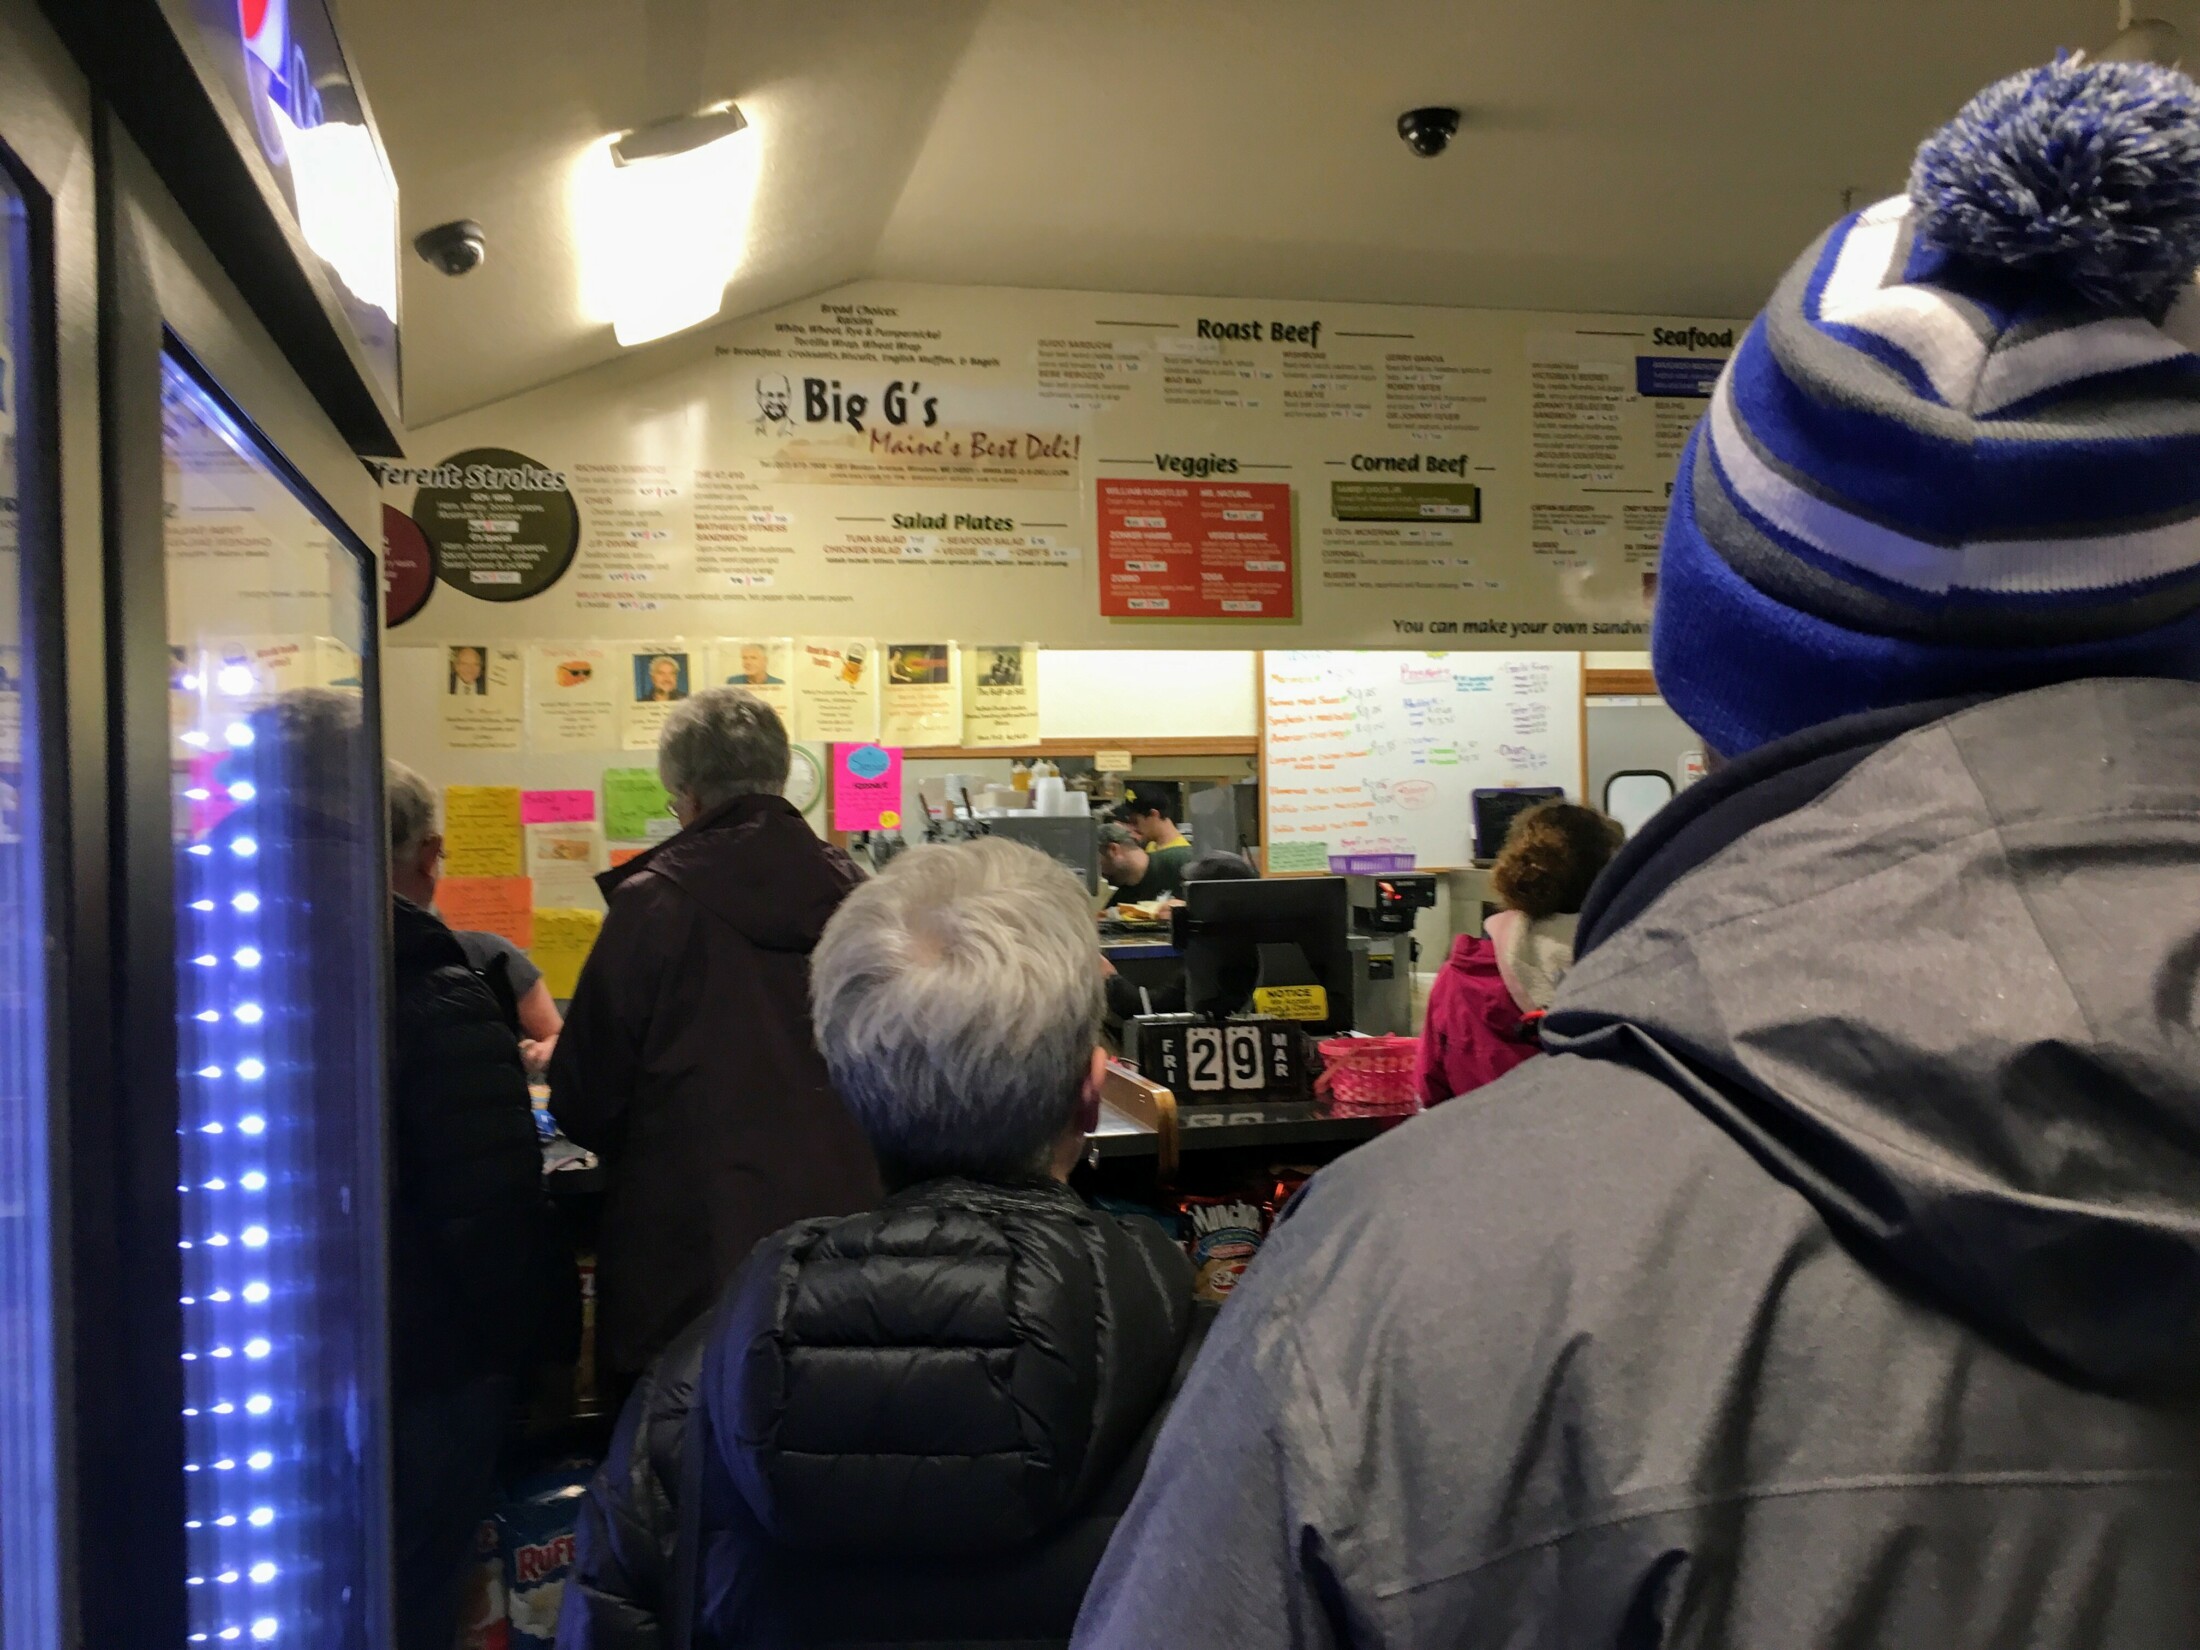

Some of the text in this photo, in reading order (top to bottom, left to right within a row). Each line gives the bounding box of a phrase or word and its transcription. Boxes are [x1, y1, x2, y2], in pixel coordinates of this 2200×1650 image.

[821, 303, 853, 313] Bread
[1197, 318, 1321, 349] Roast Beef
[1652, 326, 1733, 351] Seafood
[803, 377, 938, 433] Big G's
[869, 427, 1081, 461] Maine's Best Deli!
[1155, 453, 1240, 478] Veggies
[1351, 453, 1469, 477] Corned Beef
[464, 464, 568, 492] Strokes
[891, 512, 1014, 533] Salad Plates
[845, 533, 872, 543] TUNA
[873, 534, 907, 545] SALAD
[1393, 619, 1425, 634] You
[1429, 621, 1458, 634] can
[1462, 618, 1508, 634] make
[1510, 621, 1549, 639] your
[1552, 621, 1588, 635] own
[1267, 988, 1313, 998] NOTICE
[1161, 1038, 1176, 1084] FRI
[1191, 1036, 1258, 1082] 29
[1270, 1032, 1290, 1078] MAR
